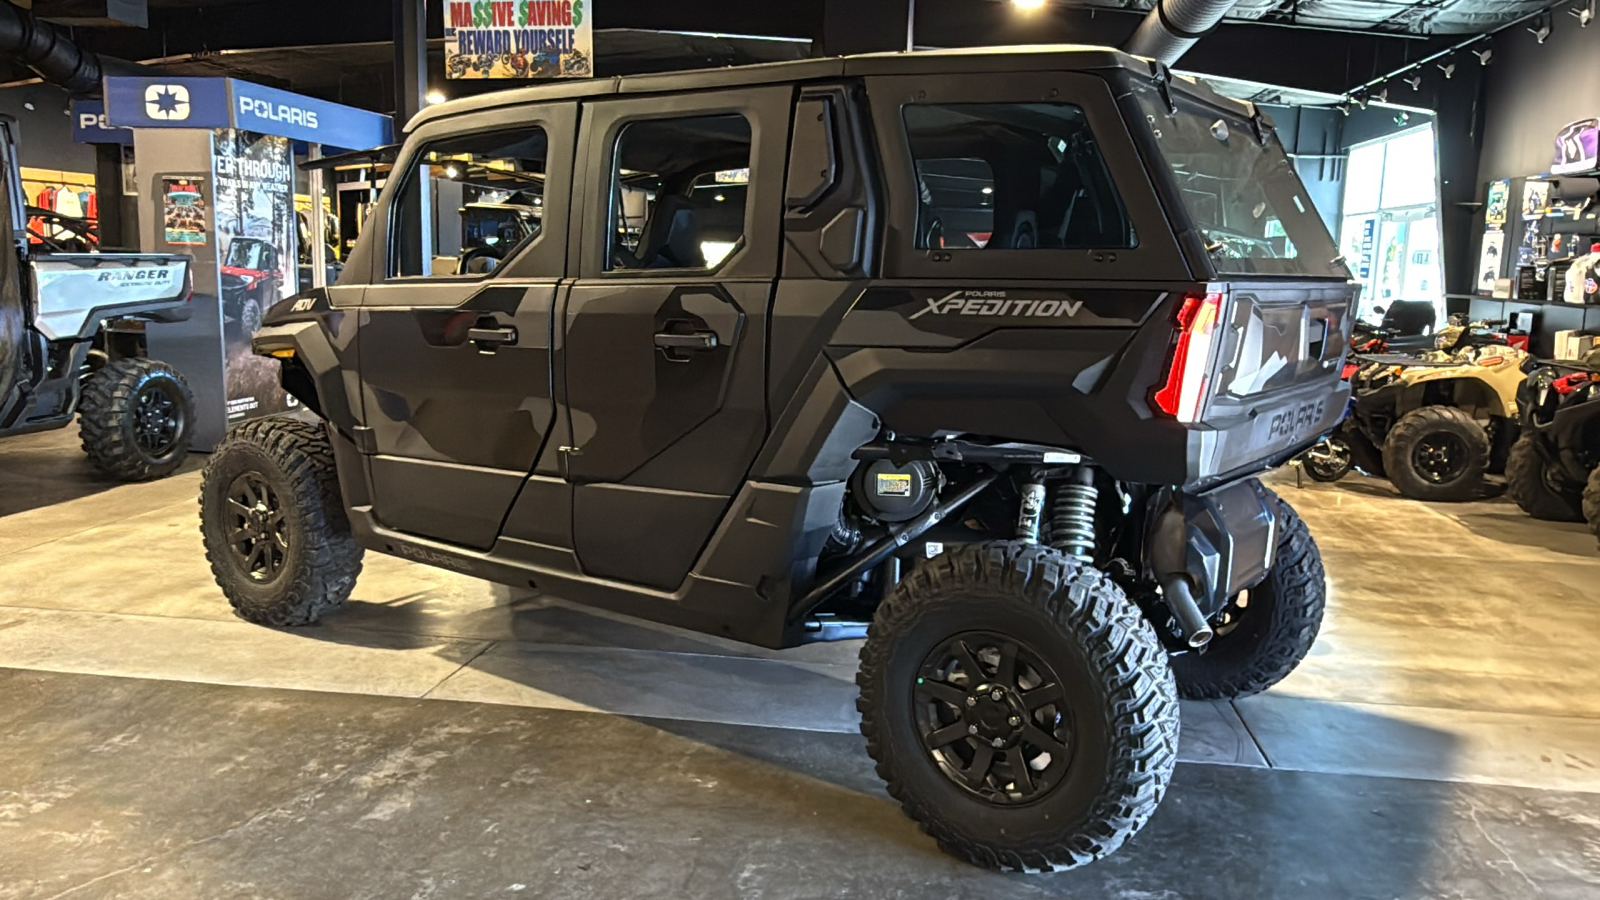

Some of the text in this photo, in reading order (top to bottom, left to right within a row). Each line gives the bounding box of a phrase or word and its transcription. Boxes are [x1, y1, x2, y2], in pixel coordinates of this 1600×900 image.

[458, 28, 575, 55] REWARD YOURSELF
[239, 95, 318, 129] POLARIS
[238, 158, 291, 182] THROUGH
[97, 269, 169, 282] RANGER
[290, 297, 318, 312] ADV
[908, 290, 1084, 320] XPEDITION
[965, 290, 1006, 298] POLARIS
[1267, 399, 1324, 441] POLARIS
